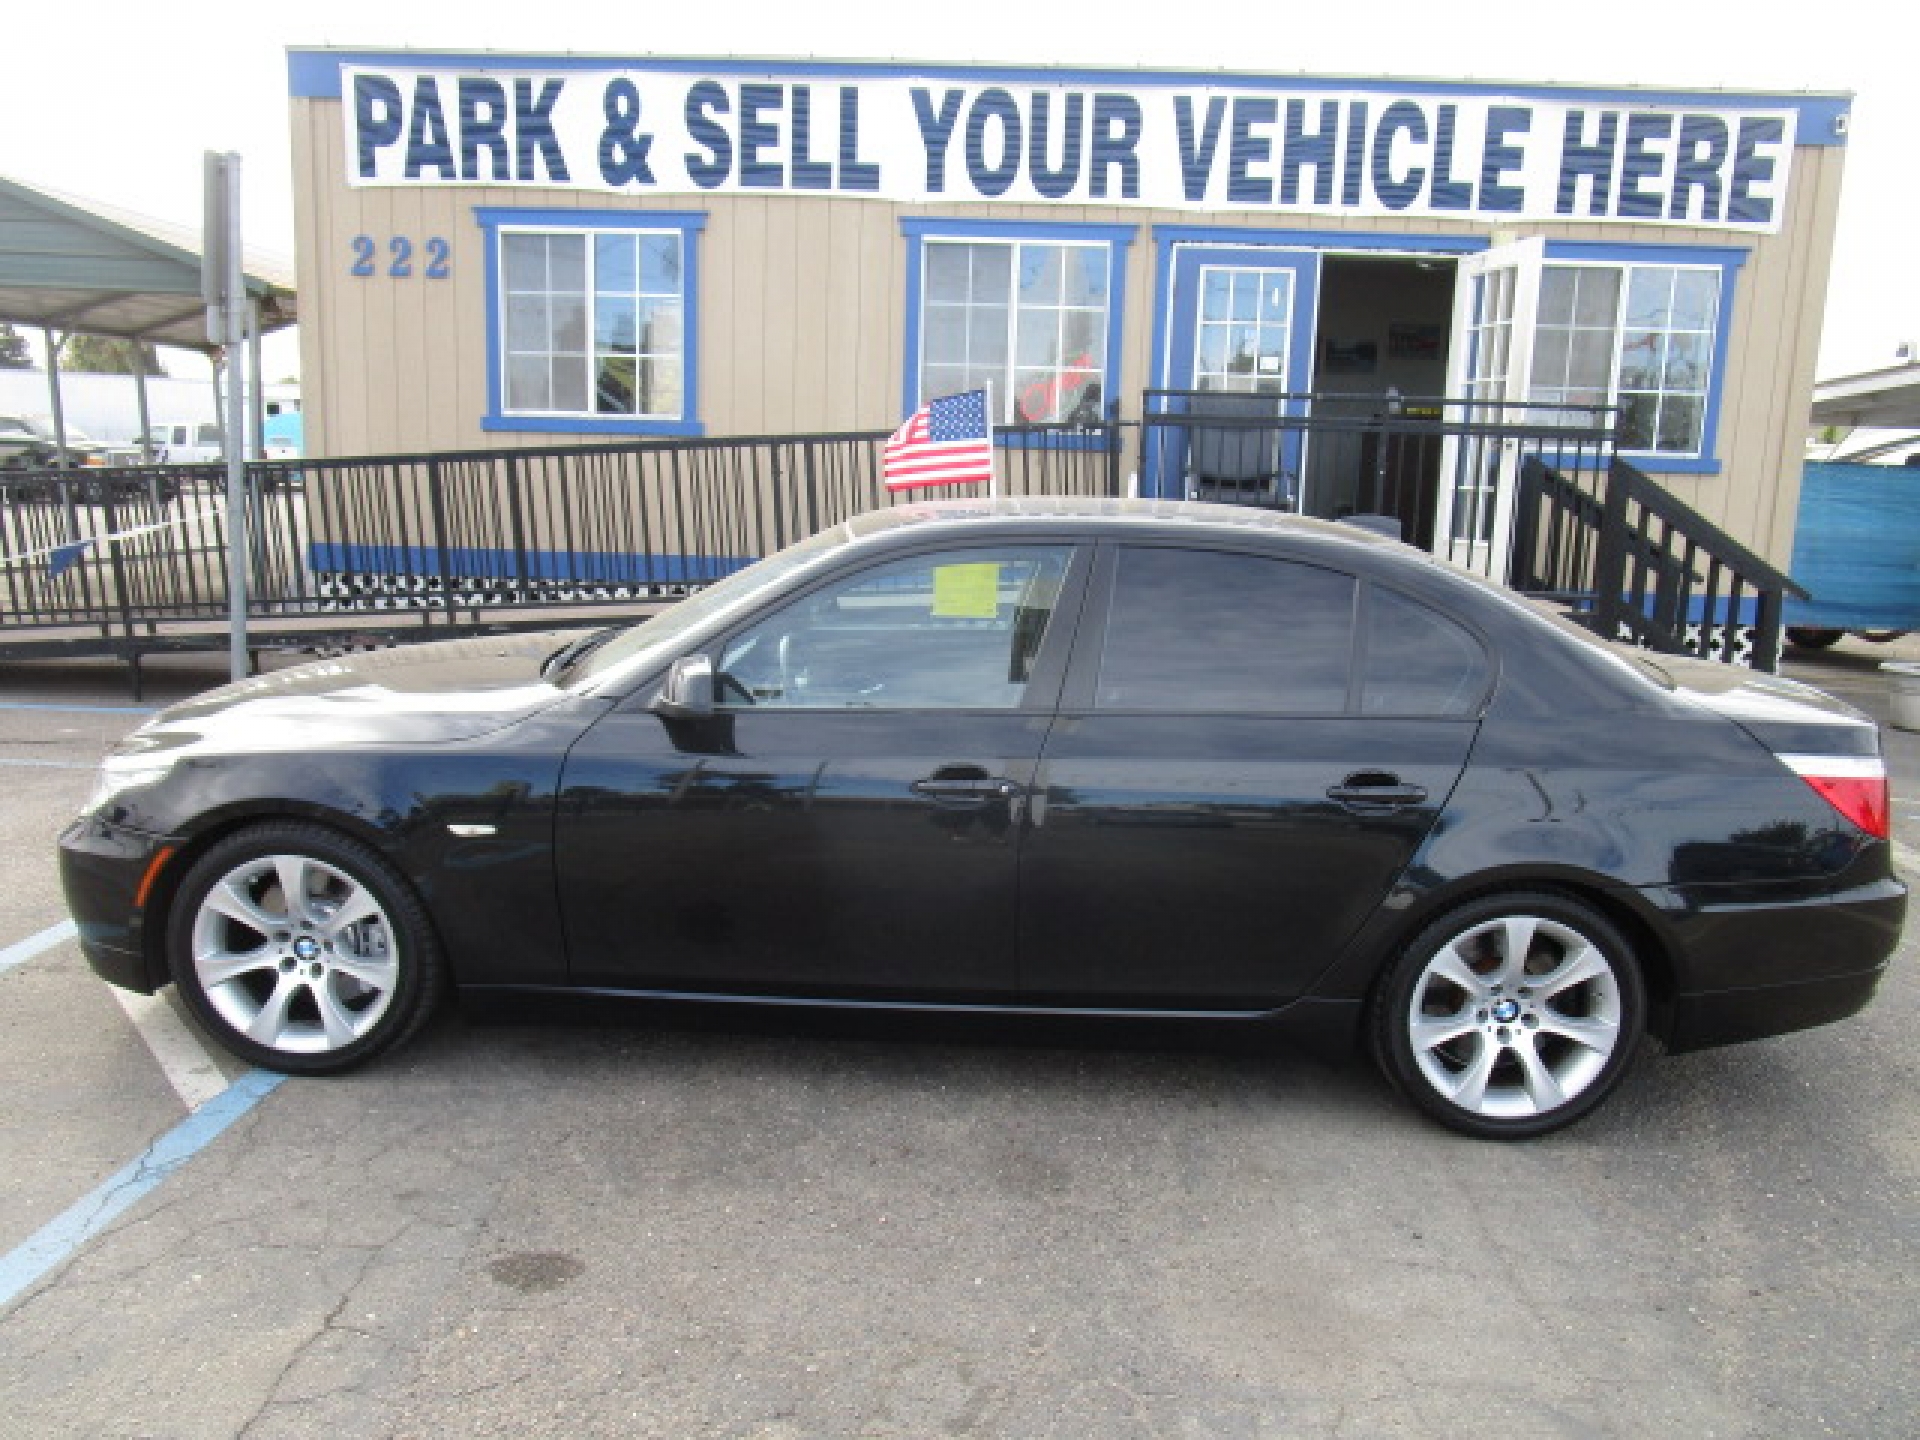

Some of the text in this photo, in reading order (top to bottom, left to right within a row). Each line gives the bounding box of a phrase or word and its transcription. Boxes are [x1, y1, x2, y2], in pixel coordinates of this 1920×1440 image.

[353, 74, 1786, 224] PARK & SELL YOUR VEHICLE HERE
[350, 235, 452, 280] 222
